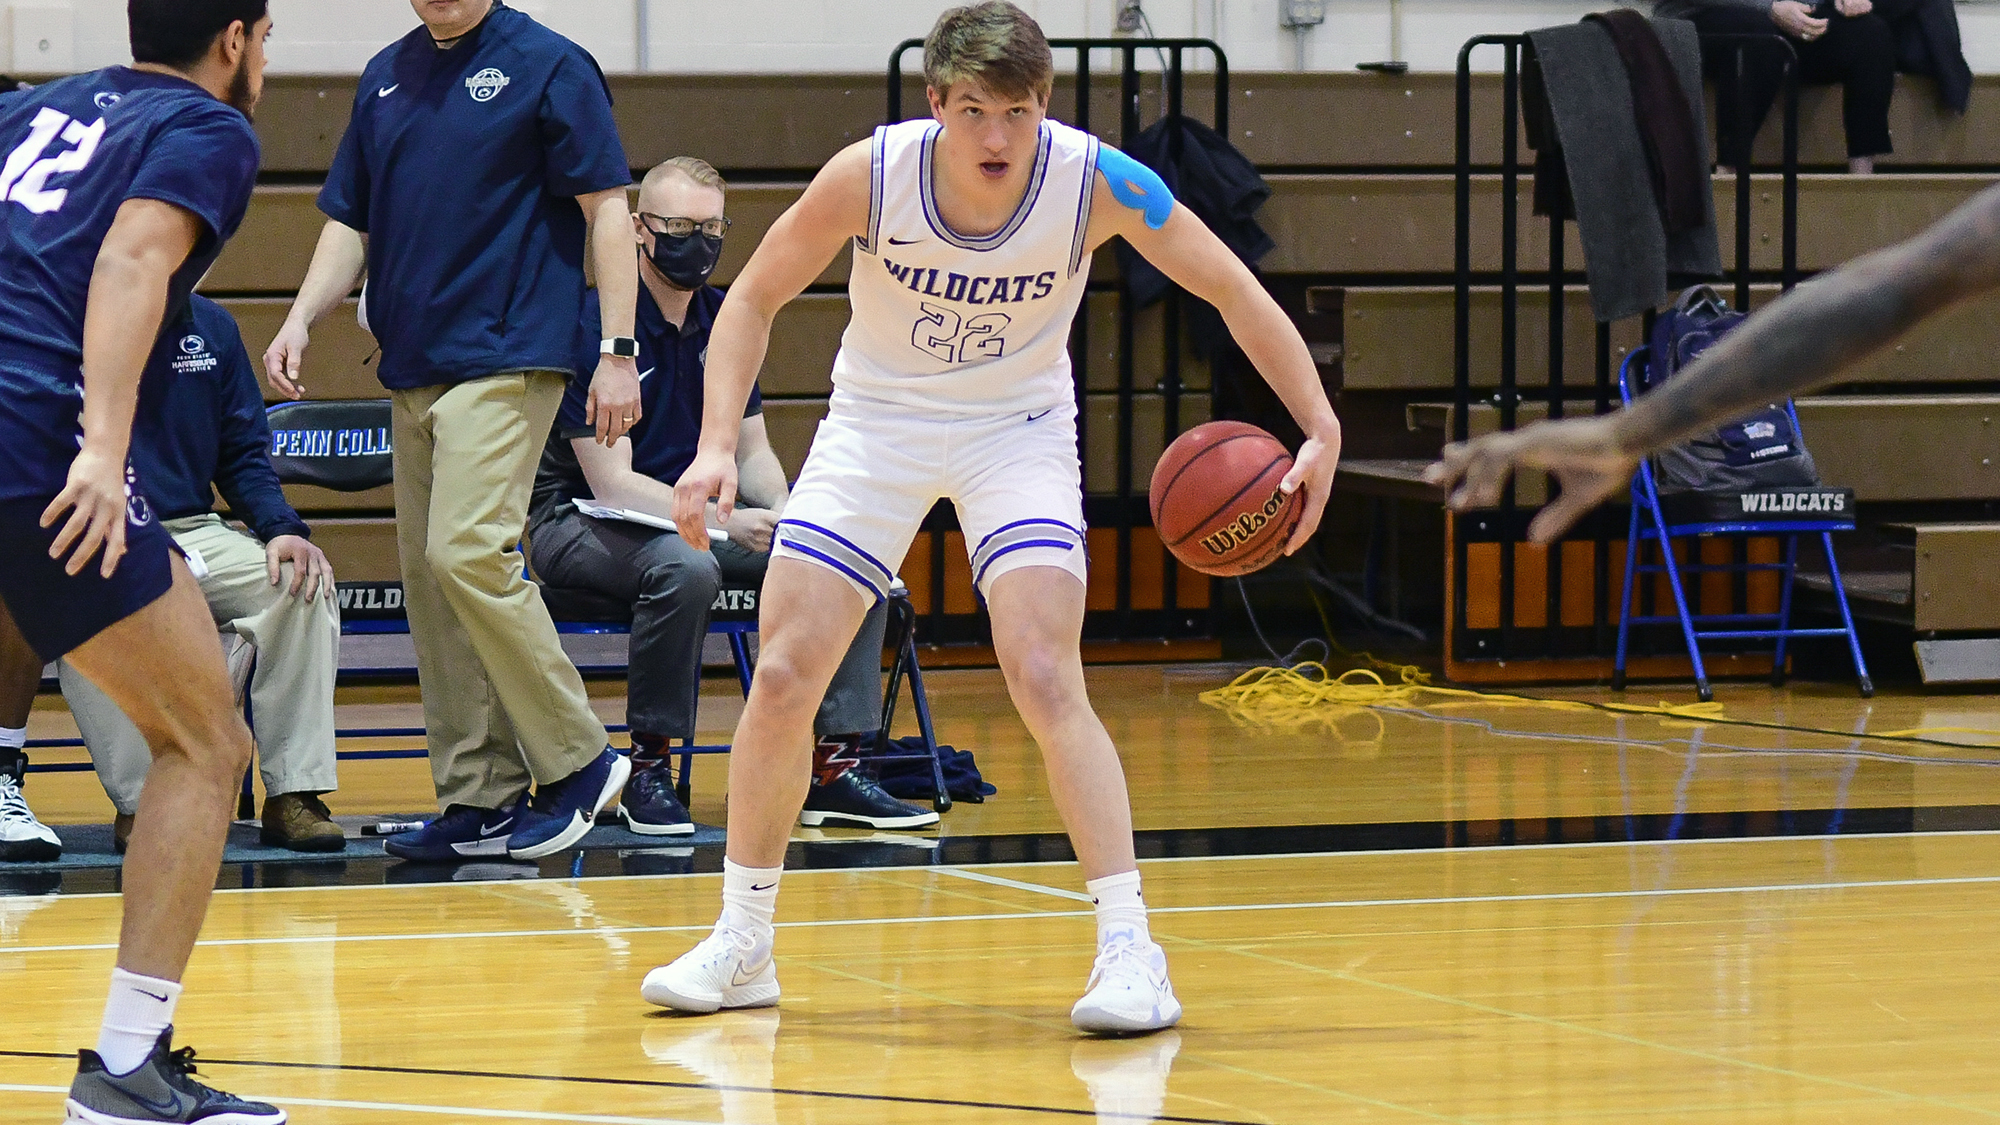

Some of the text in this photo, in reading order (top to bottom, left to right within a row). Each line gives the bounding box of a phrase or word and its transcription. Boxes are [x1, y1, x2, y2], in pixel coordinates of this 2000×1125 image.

[0, 106, 107, 214] 12
[884, 258, 1056, 304] WILDCATS
[911, 301, 1012, 363] 22
[271, 427, 393, 457] PENN COLL
[1741, 493, 1845, 512] WILDCATS
[338, 588, 406, 609] WILD
[711, 590, 756, 610] ATS
